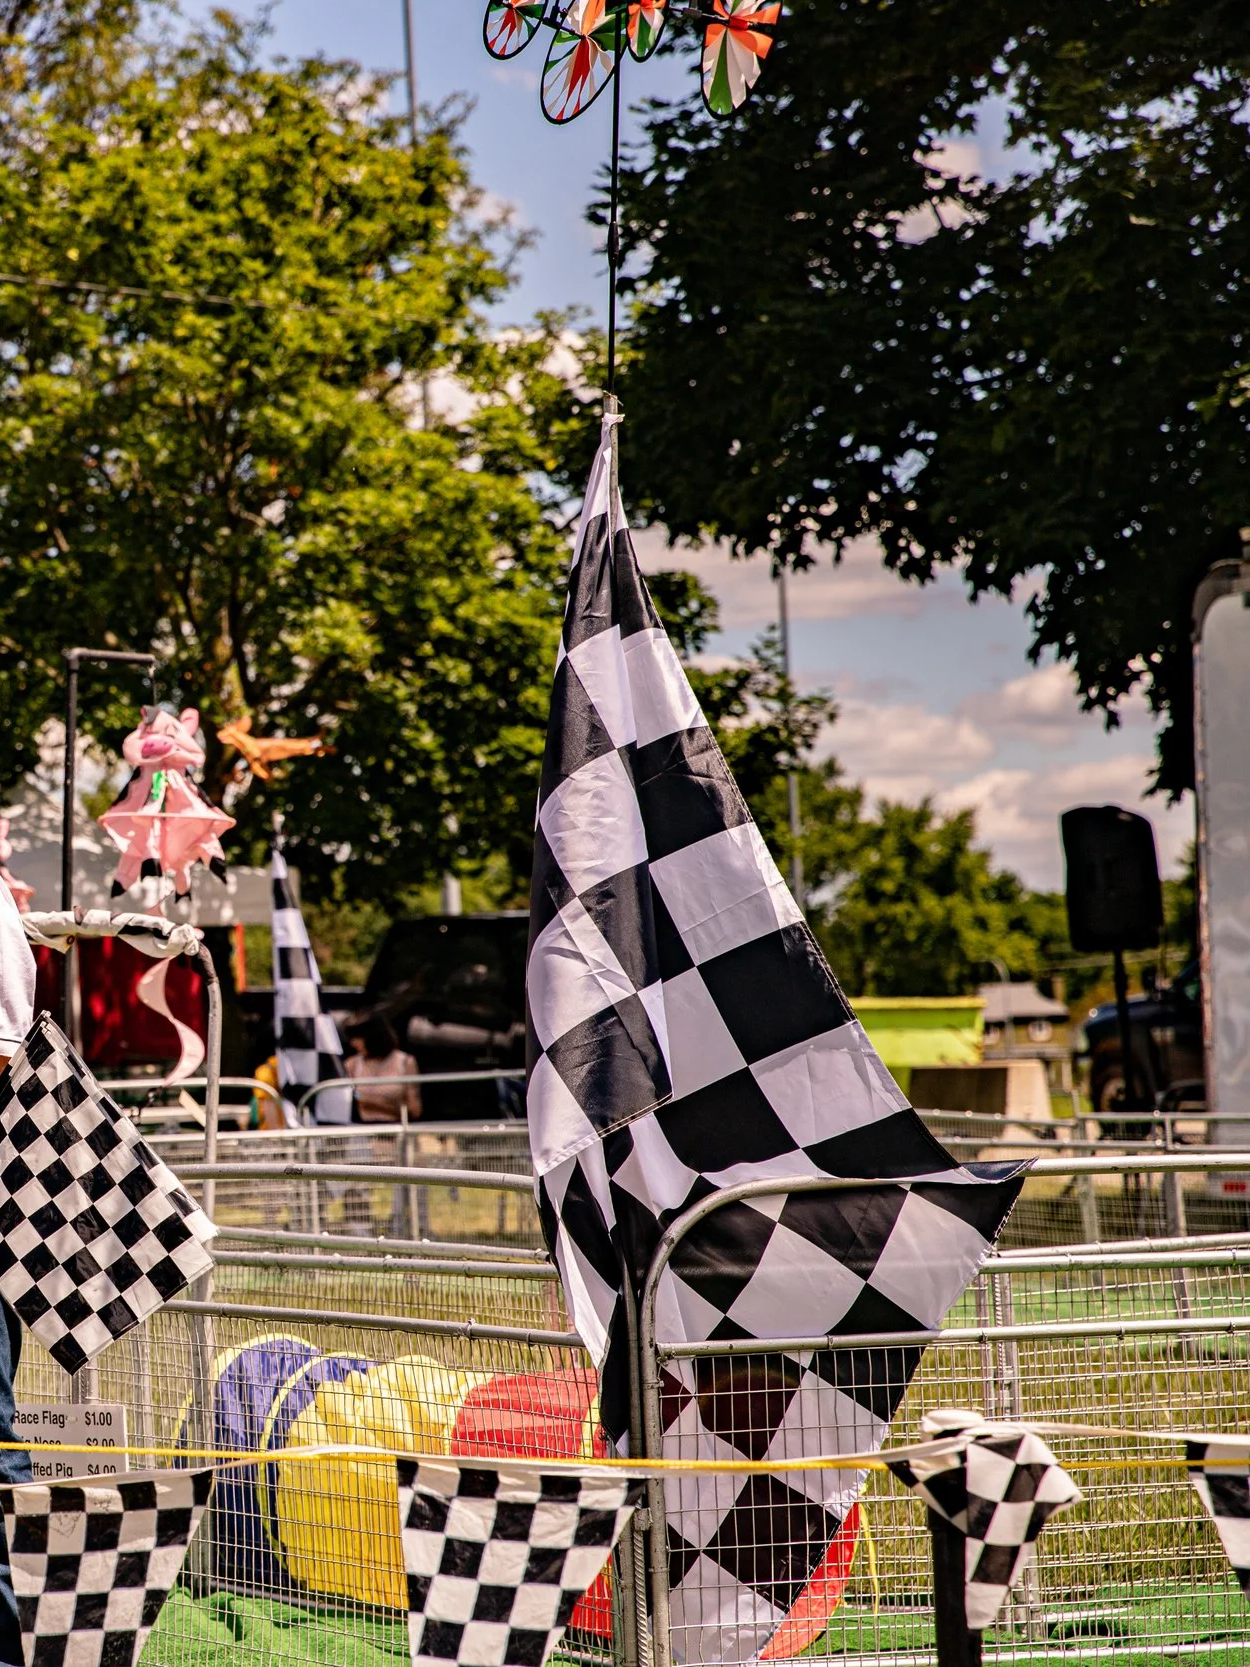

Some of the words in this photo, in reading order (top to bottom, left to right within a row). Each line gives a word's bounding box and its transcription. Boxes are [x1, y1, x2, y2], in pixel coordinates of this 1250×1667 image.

[14, 1410, 39, 1425] Race
[42, 1410, 65, 1429] Flag
[85, 1411, 112, 1426] $1.00
[86, 1437, 115, 1447] $200
[32, 1462, 53, 1477] ffed
[88, 1463, 116, 1475] $400
